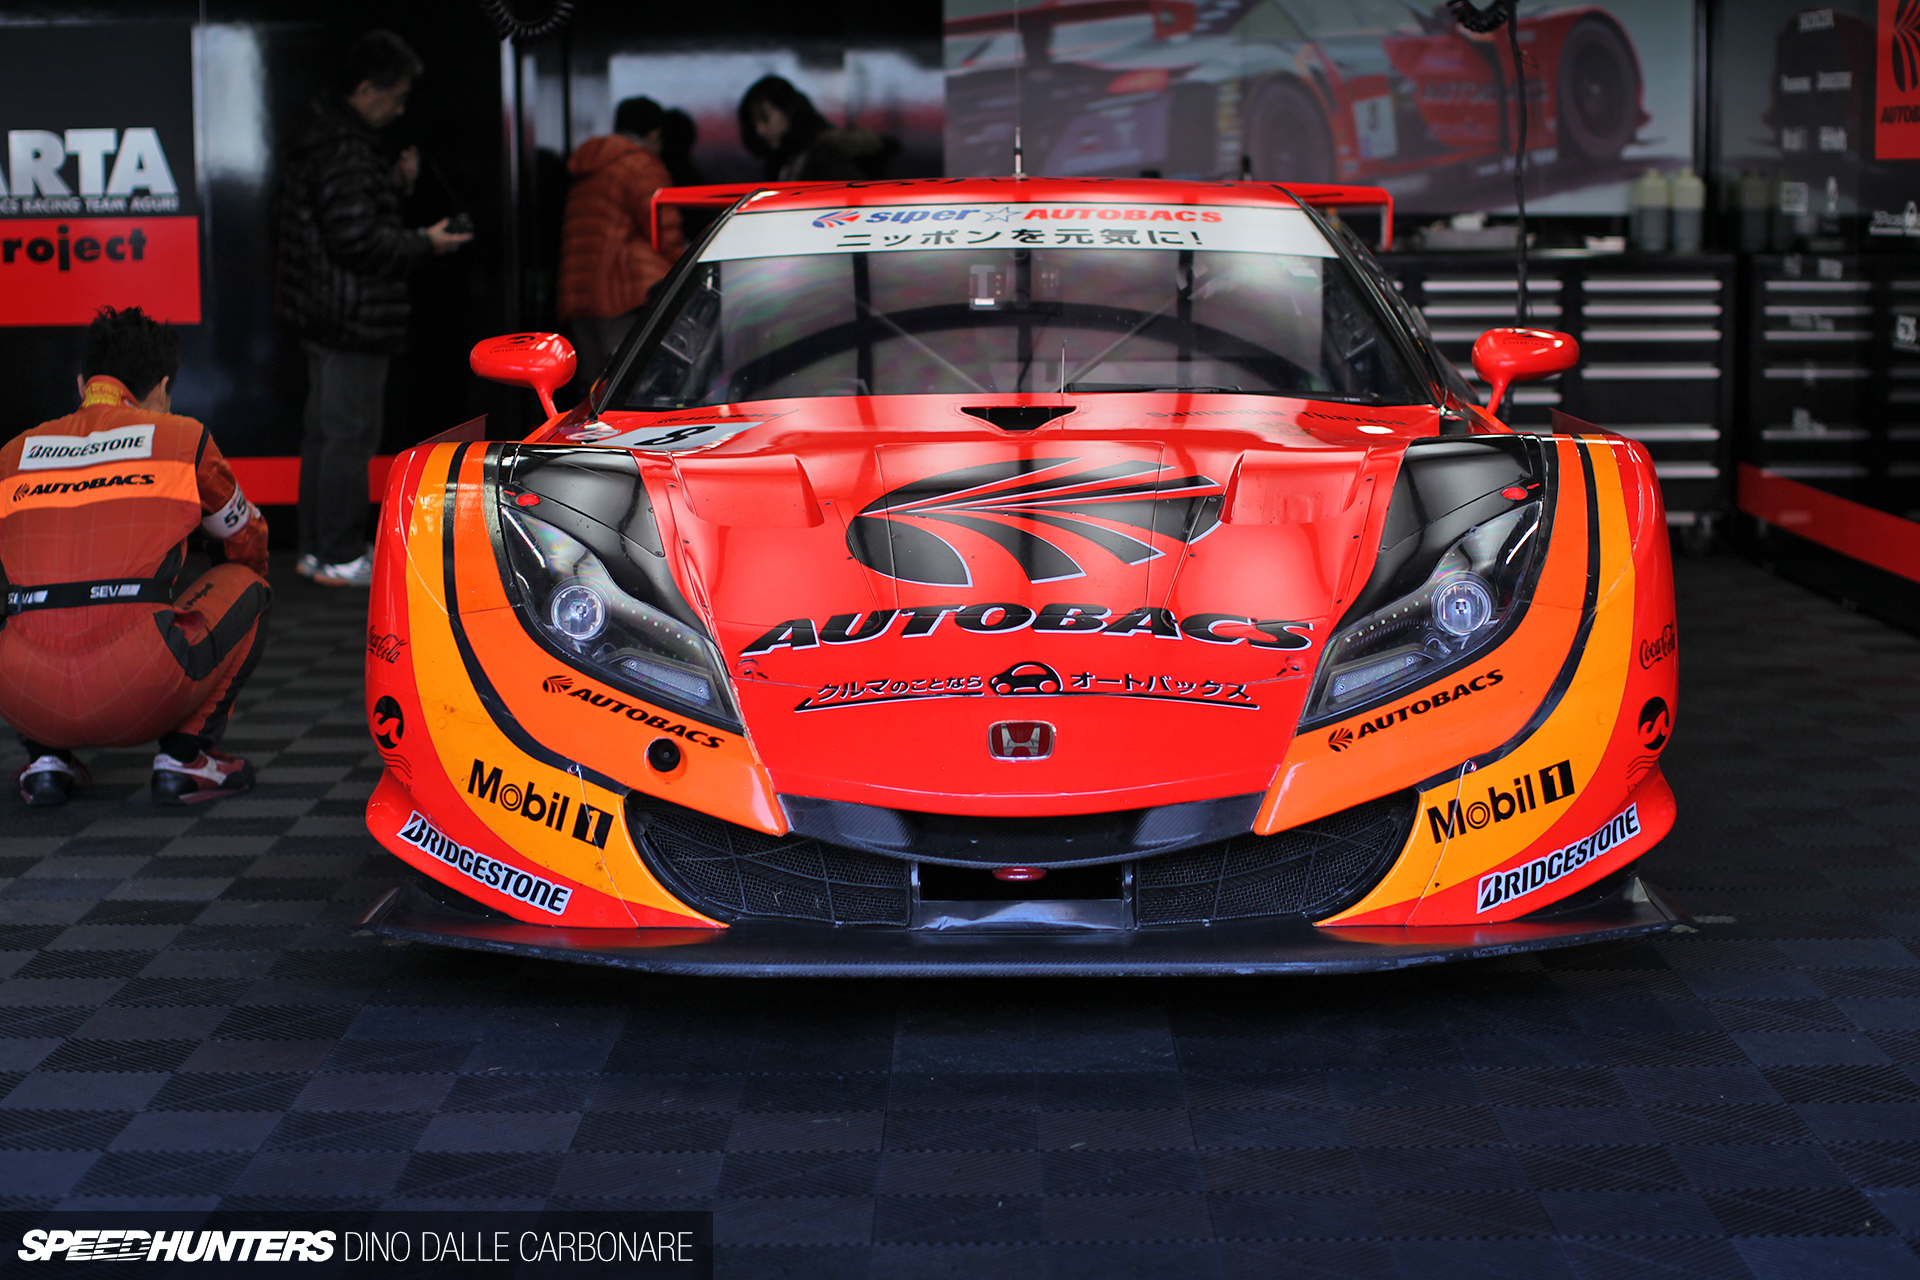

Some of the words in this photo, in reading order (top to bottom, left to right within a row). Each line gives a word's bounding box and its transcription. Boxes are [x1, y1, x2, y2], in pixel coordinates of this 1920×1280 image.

[0, 127, 178, 197] RTA
[22, 197, 81, 213] RACING
[84, 197, 127, 212] TEAM
[130, 196, 179, 212] AGURI
[1022, 208, 1223, 223] AUTOBACS
[1146, 409, 1287, 418] Samantha
[26, 436, 146, 459] BRIDGESTONE
[633, 425, 716, 446] 8
[28, 474, 155, 497] AUTOBACS
[224, 497, 247, 528] 55
[740, 603, 1313, 657] AUTOBACS
[816, 676, 983, 704] クルマのことなら
[1071, 672, 1252, 702] オートバックス
[1357, 668, 1504, 740] AUTOBACS
[569, 687, 725, 749] AUTOBACS
[467, 758, 571, 832] Mobil
[1427, 773, 1537, 844] Mobil
[401, 817, 569, 913] BRIDGESTONE
[1480, 805, 1638, 903] BRIDGESTONE
